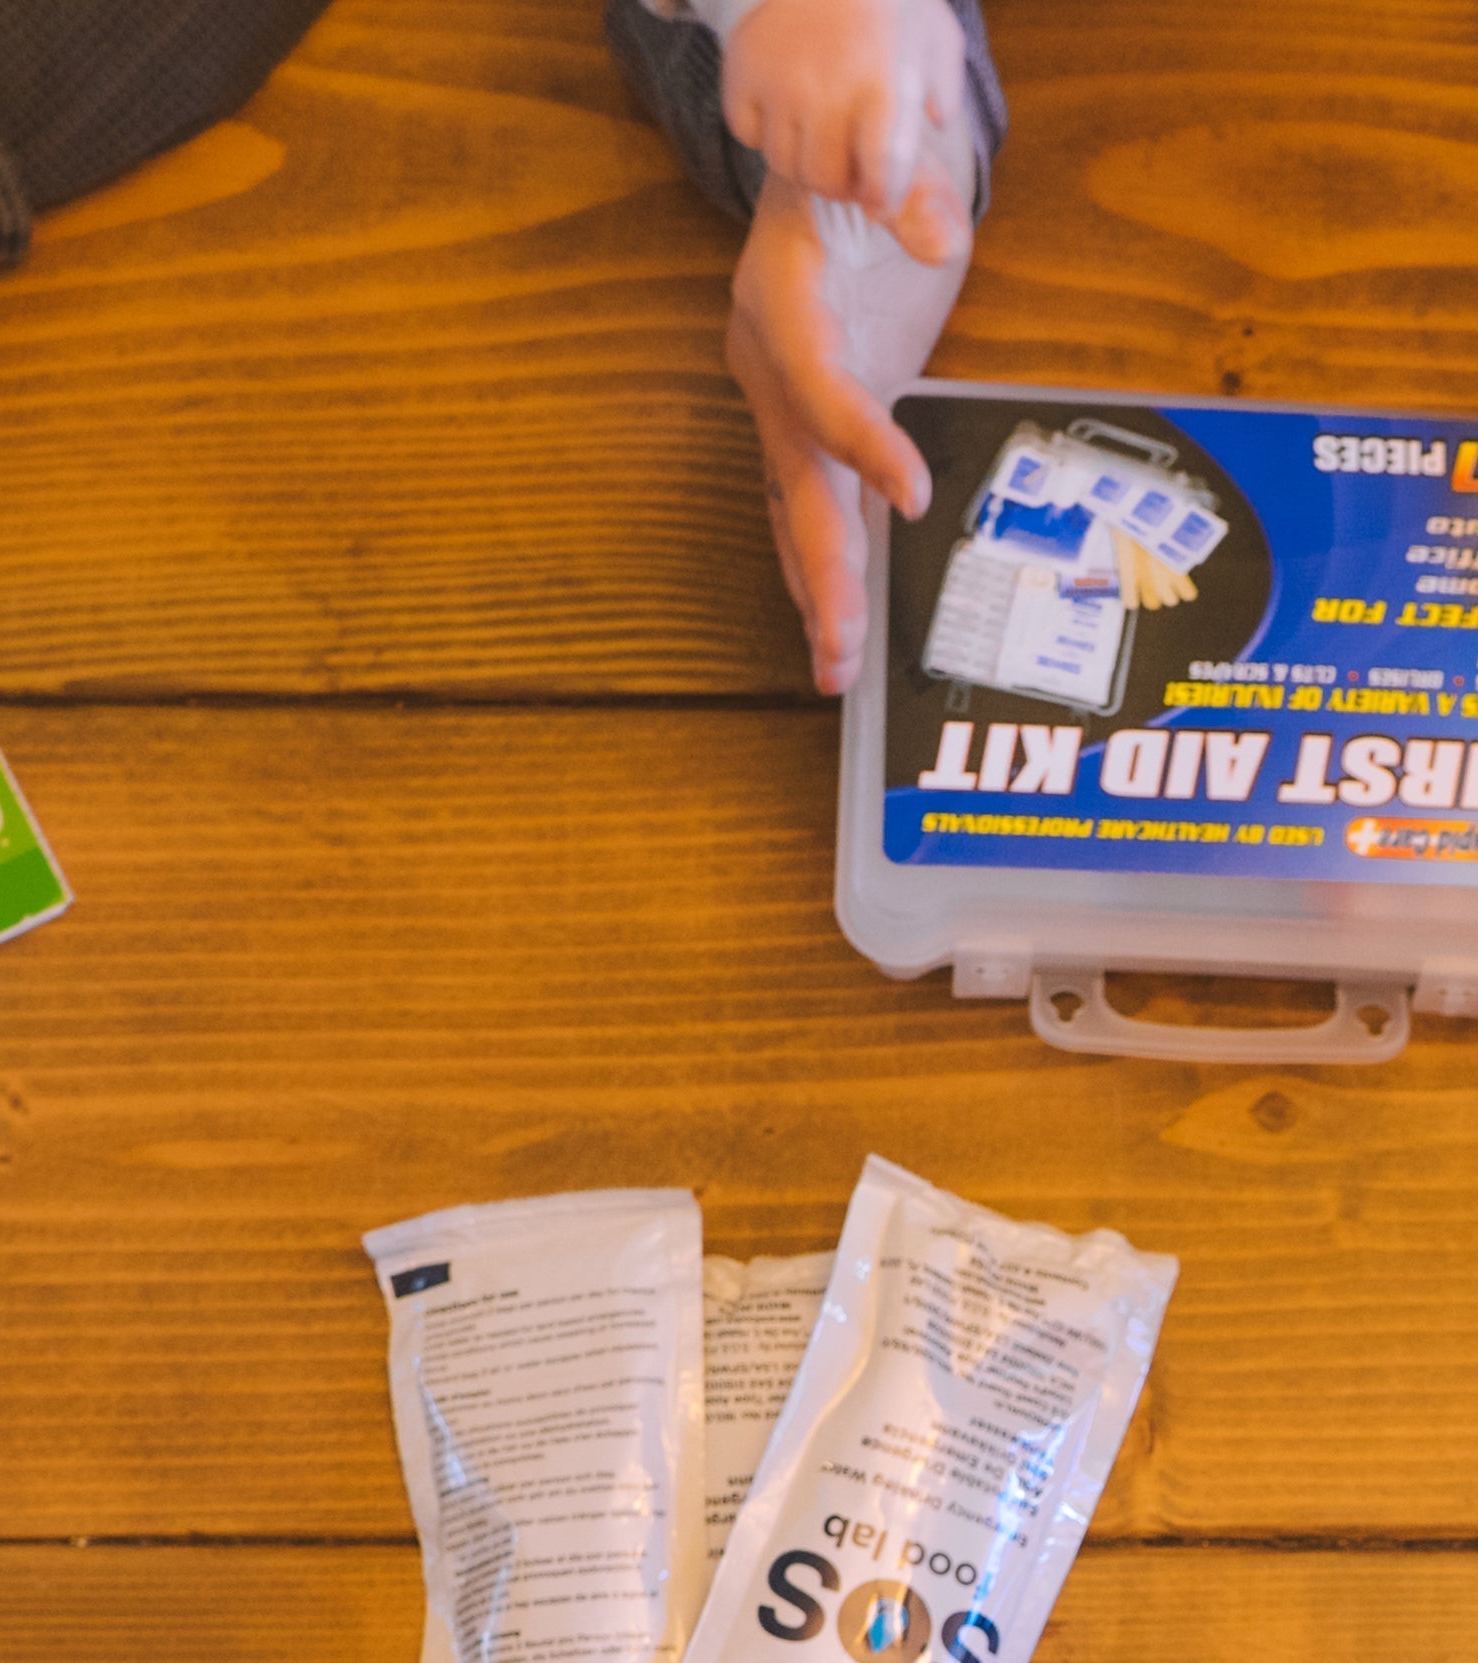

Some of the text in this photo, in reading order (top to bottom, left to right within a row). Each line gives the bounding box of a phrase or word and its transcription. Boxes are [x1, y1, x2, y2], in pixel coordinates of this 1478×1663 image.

[1310, 432, 1447, 479] PIECES
[1311, 595, 1386, 625] FOR
[1287, 683, 1322, 711] OF
[1325, 686, 1430, 715] VARIETY
[1435, 691, 1457, 717] A
[918, 719, 1083, 794] KIT
[1100, 728, 1270, 801] AID
[920, 811, 1324, 847] USED BY HEALTHCARE PROFESSIONALS
[822, 1513, 887, 1559] lab
